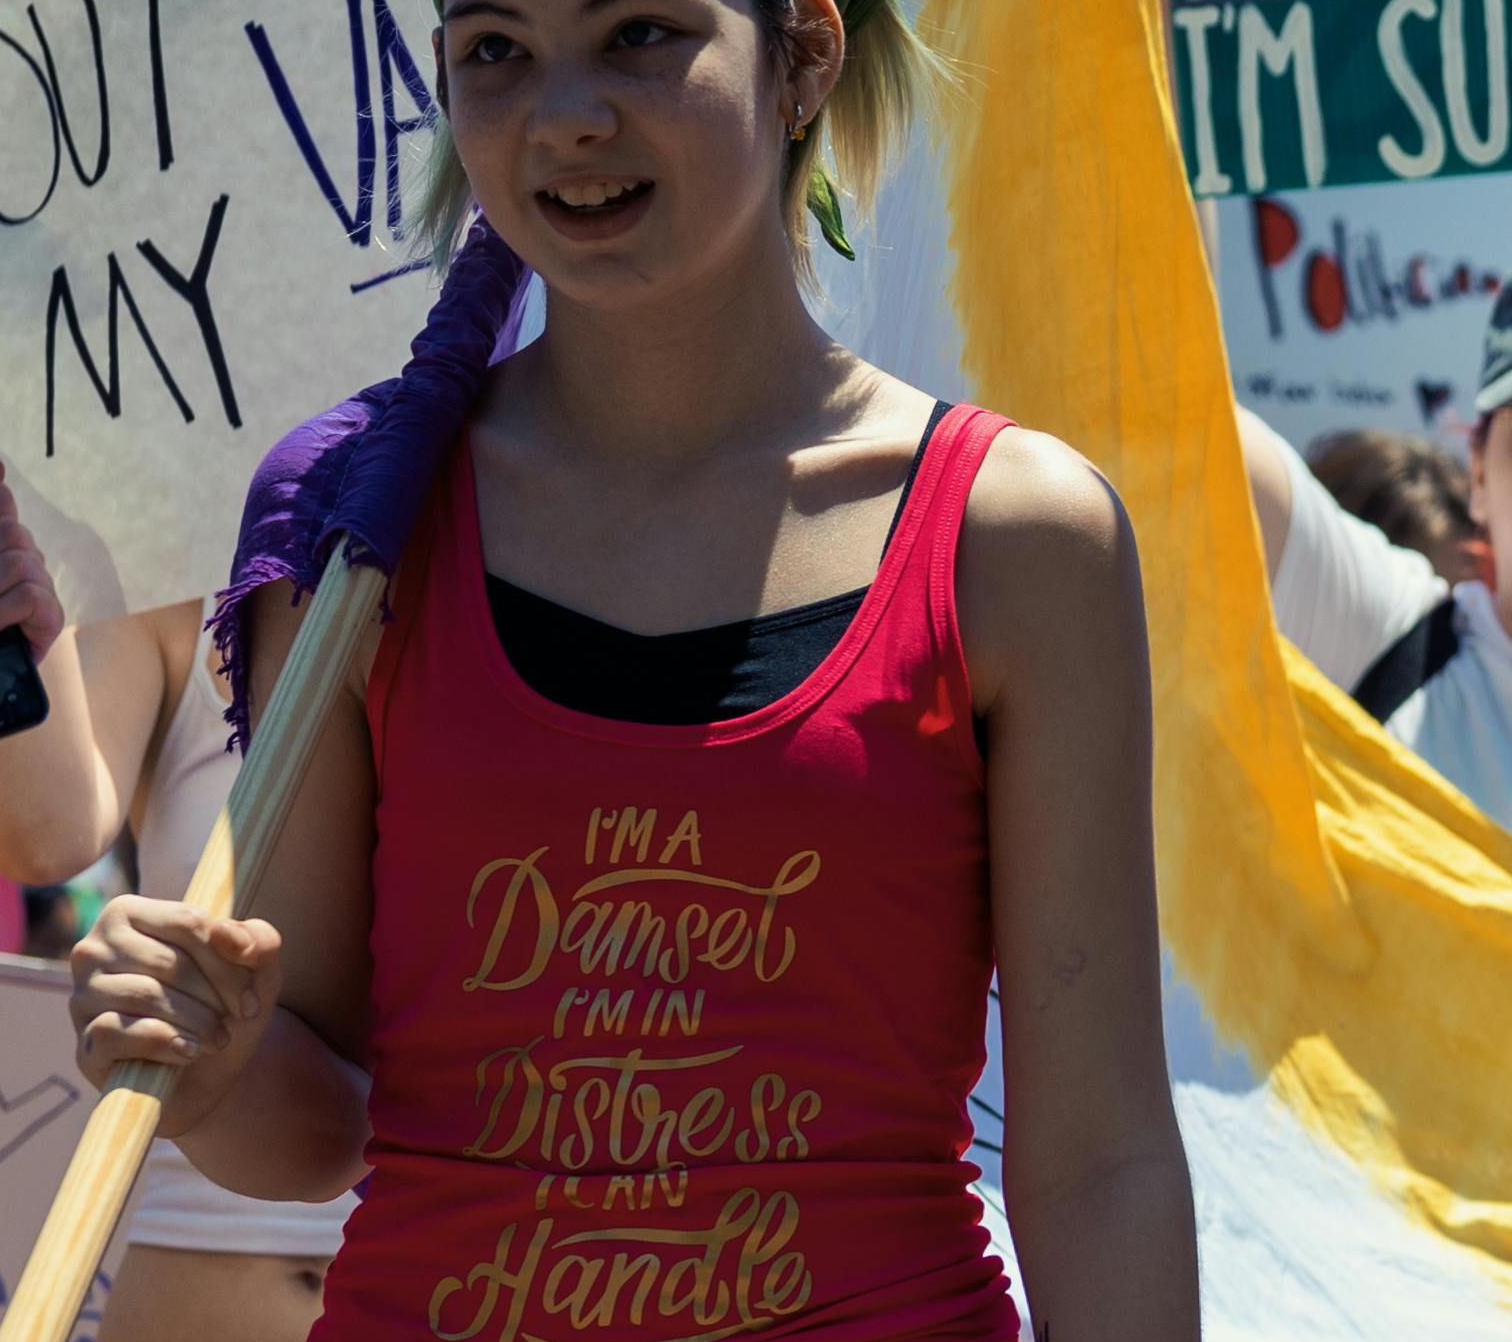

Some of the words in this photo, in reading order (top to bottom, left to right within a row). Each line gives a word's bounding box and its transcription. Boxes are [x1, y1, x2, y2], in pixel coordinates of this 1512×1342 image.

[1175, 0, 1324, 194] I'M
[45, 193, 243, 458] MY
[586, 806, 659, 864] I'M
[660, 809, 702, 865] A
[463, 846, 822, 992] Damsel
[553, 987, 636, 1039] I'M
[640, 990, 706, 1037] IN
[462, 1035, 823, 1169] Distress
